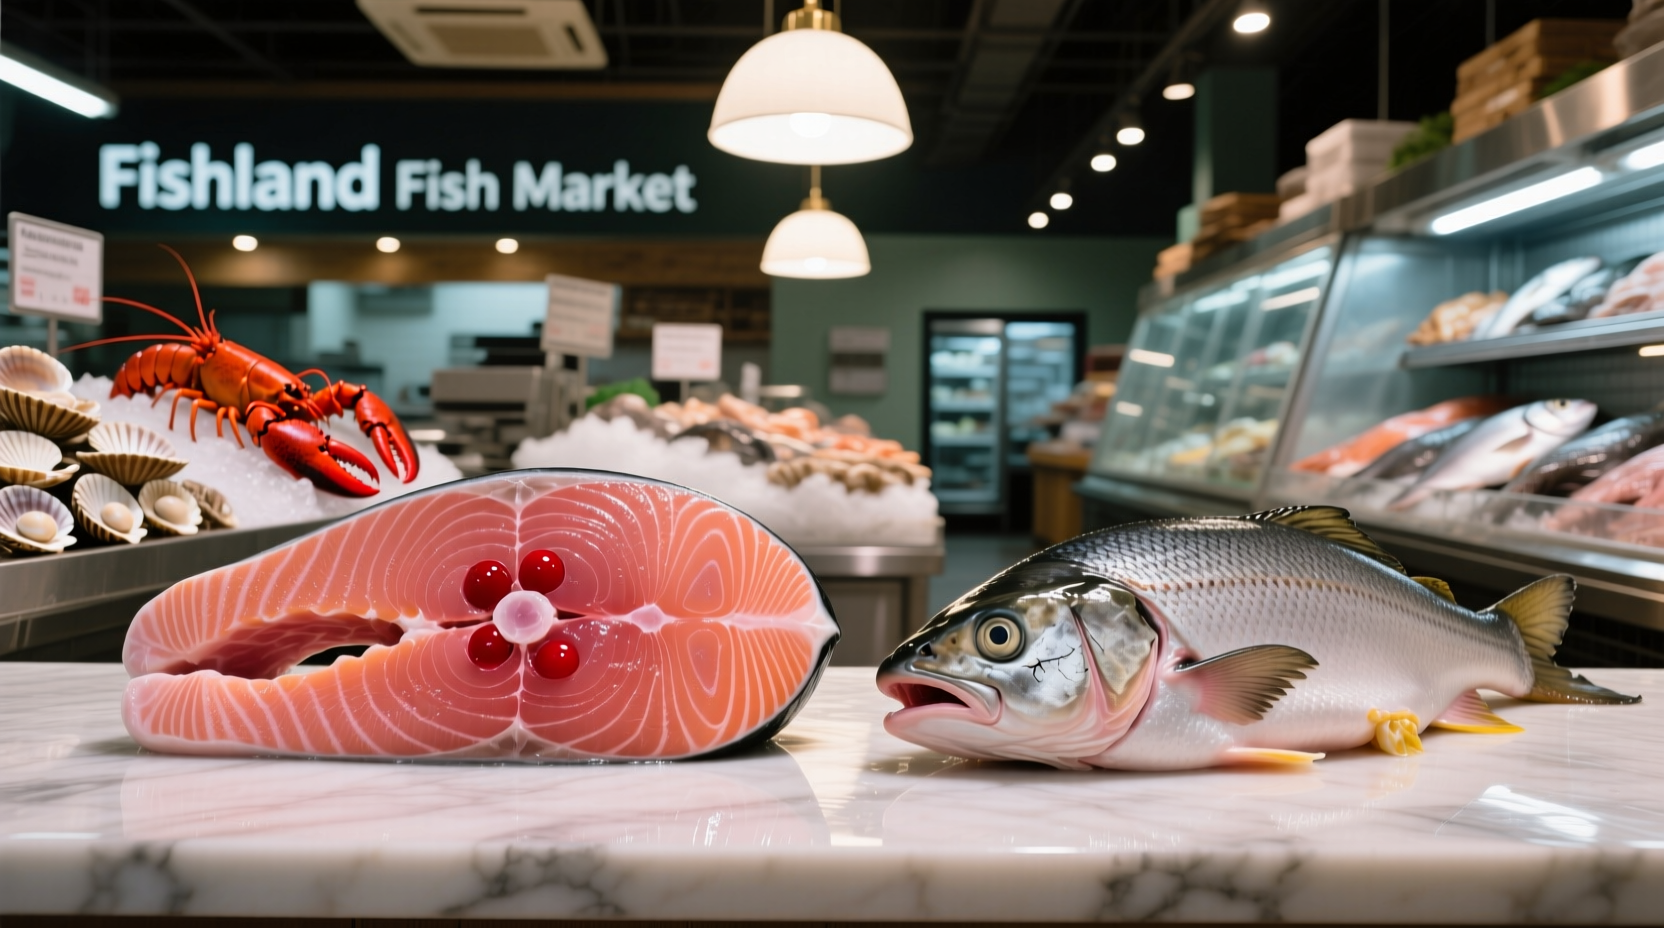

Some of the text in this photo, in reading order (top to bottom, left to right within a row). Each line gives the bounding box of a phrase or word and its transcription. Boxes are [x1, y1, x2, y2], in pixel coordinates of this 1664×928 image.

[98, 141, 697, 213] Fishland Fish Market
